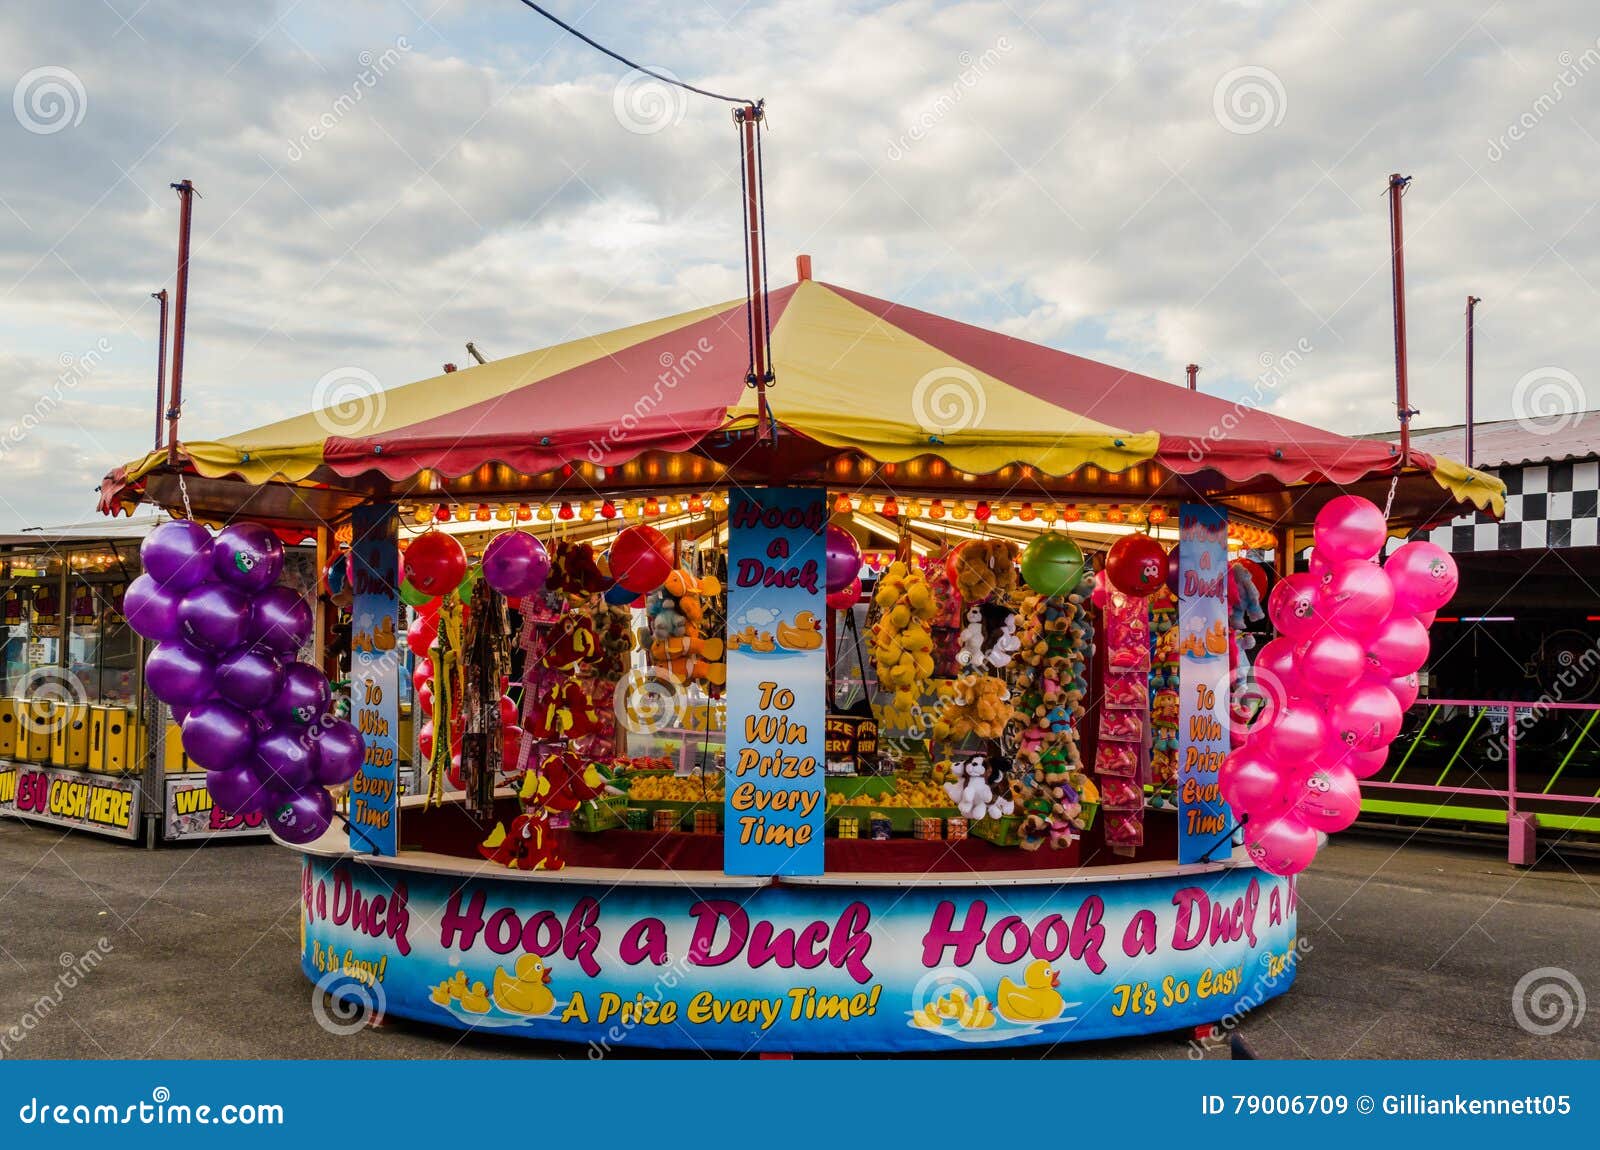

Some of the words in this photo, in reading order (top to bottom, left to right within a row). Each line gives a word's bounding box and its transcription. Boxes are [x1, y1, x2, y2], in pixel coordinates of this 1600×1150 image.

[733, 499, 823, 535] Hook
[767, 537, 789, 558] a
[736, 558, 818, 595] Duck
[1184, 569, 1225, 605] Duck
[364, 679, 383, 706] To
[758, 681, 795, 711] To
[1196, 683, 1215, 711] To
[358, 708, 389, 738] Win
[744, 715, 807, 745] Win
[826, 719, 854, 737] IZE
[1189, 714, 1222, 742] Win
[365, 740, 394, 768] rize
[825, 740, 850, 752] ERY
[858, 740, 876, 752] EVERY
[735, 747, 816, 780] Prize
[17, 771, 48, 814] £50
[50, 779, 89, 820] CASH
[88, 785, 133, 829] HERE
[352, 769, 394, 803] Every
[731, 782, 821, 818] Every
[355, 799, 390, 830] Time
[1187, 808, 1225, 836] Time
[738, 816, 812, 848] Time
[332, 867, 412, 957] Duck
[921, 894, 1108, 974] Hook
[1122, 908, 1157, 958] a
[1170, 875, 1260, 952] Duck
[439, 888, 602, 978] Hook
[618, 917, 667, 965] a
[688, 899, 872, 984] Duck
[343, 949, 388, 989] Easy!
[561, 991, 589, 1023] A
[597, 991, 677, 1027] Prize
[686, 991, 785, 1030] Every
[787, 984, 882, 1021] Time!
[1111, 981, 1157, 1017] It's
[1161, 974, 1190, 1008] So
